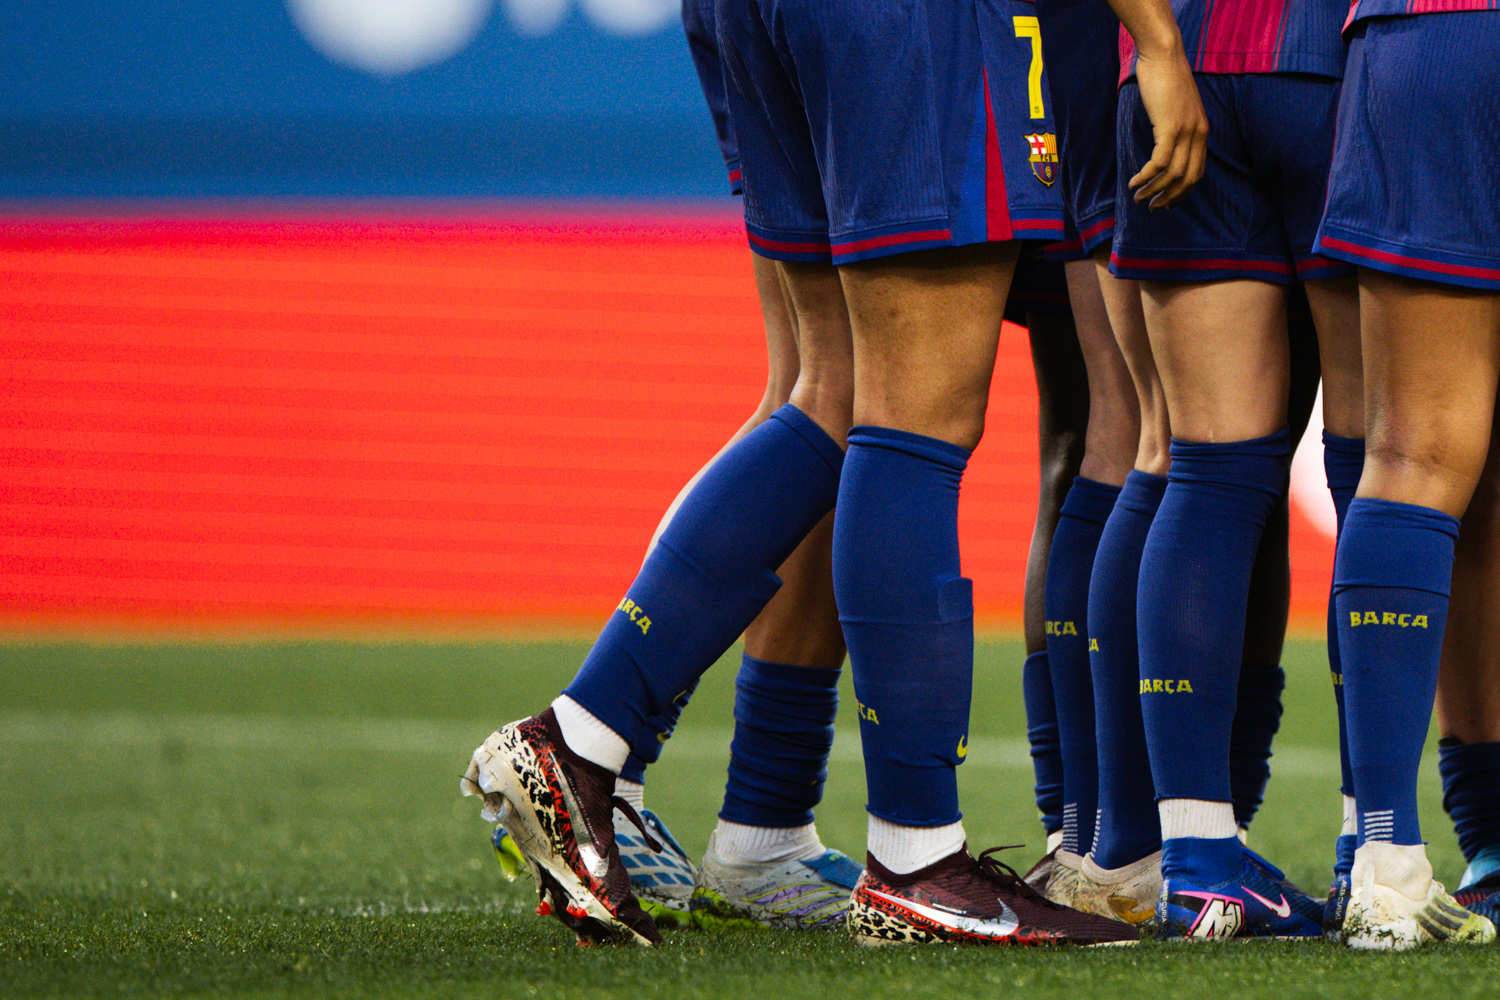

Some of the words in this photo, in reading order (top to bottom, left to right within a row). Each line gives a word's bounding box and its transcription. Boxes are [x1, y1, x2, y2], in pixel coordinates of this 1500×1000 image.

[1012, 16, 1045, 119] 7
[1040, 154, 1053, 162] FCB
[1350, 611, 1428, 628] BARÇA
